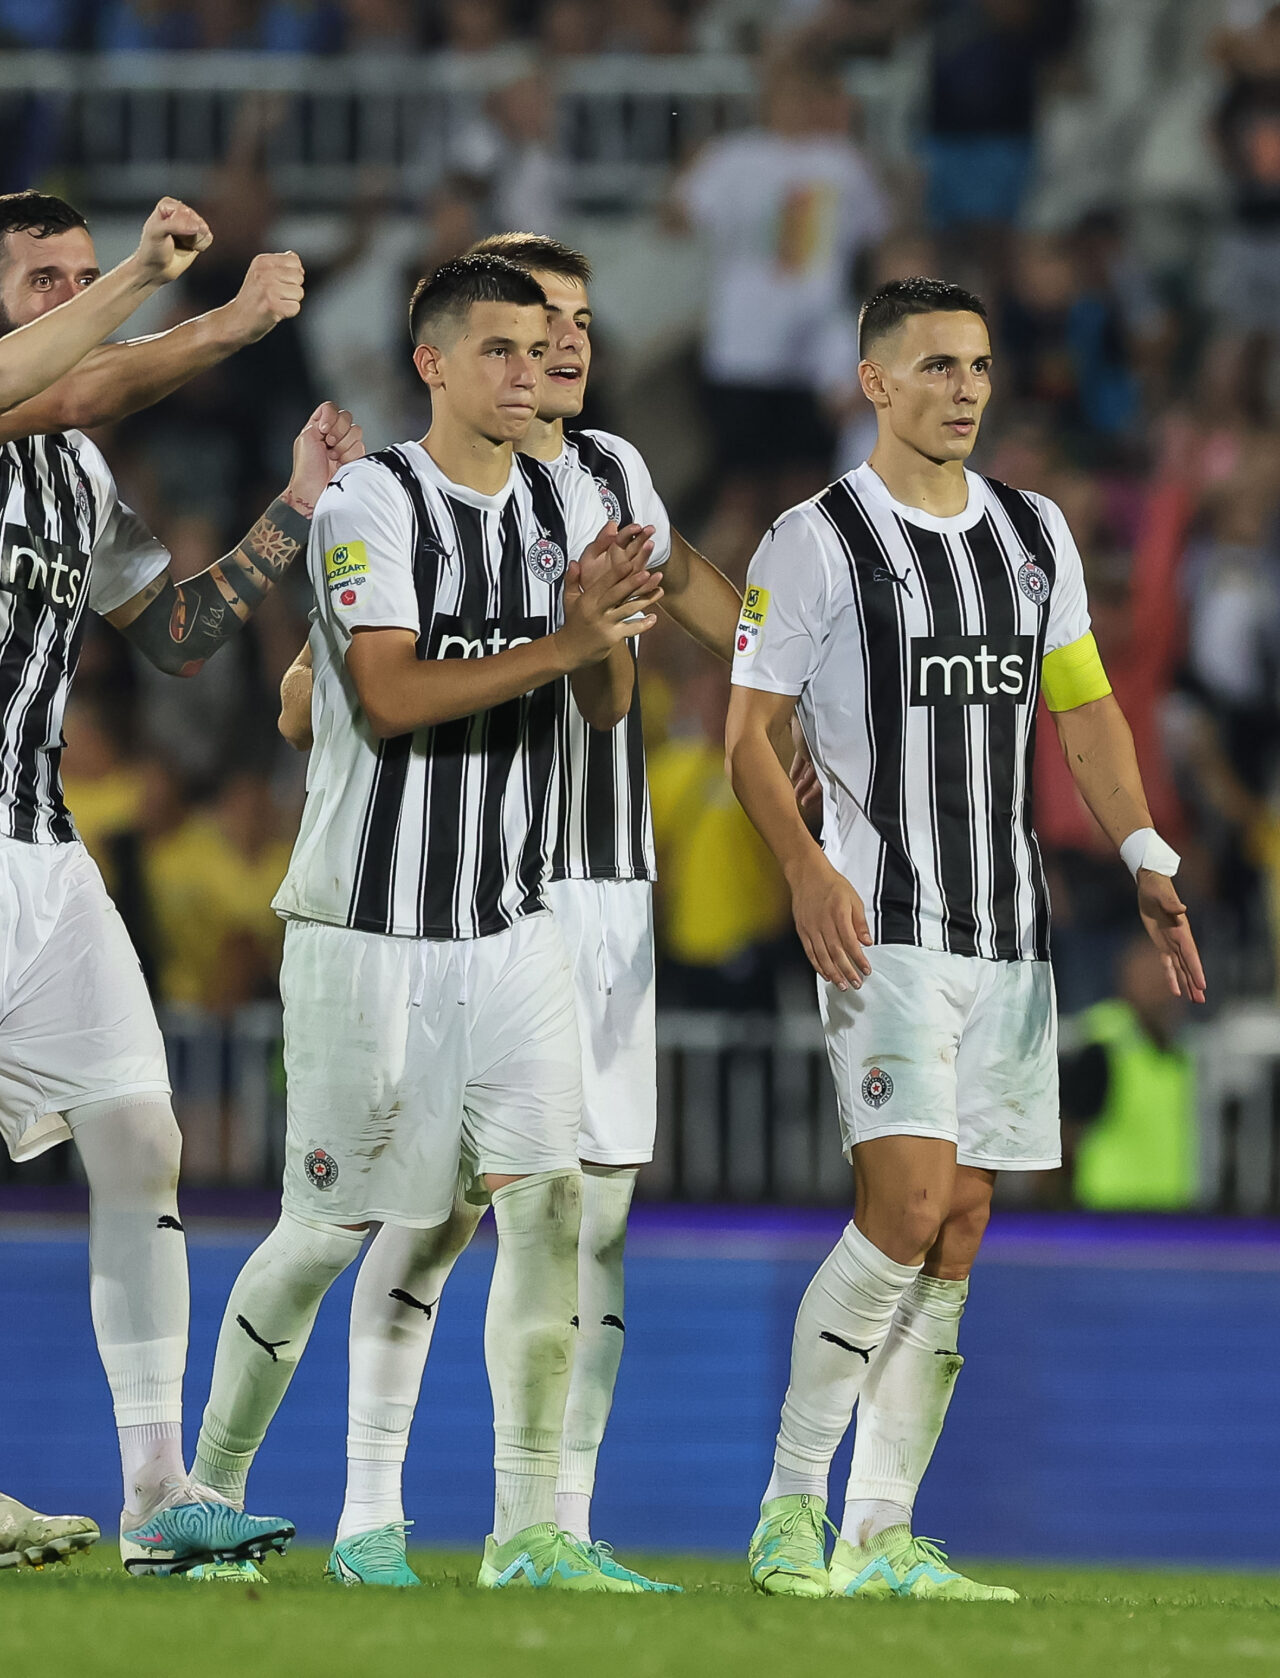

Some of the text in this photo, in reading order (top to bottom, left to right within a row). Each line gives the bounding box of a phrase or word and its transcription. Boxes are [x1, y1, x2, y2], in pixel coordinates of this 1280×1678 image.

[9, 545, 81, 608] mts
[743, 608, 764, 623] ZZART
[920, 645, 1024, 697] mts
